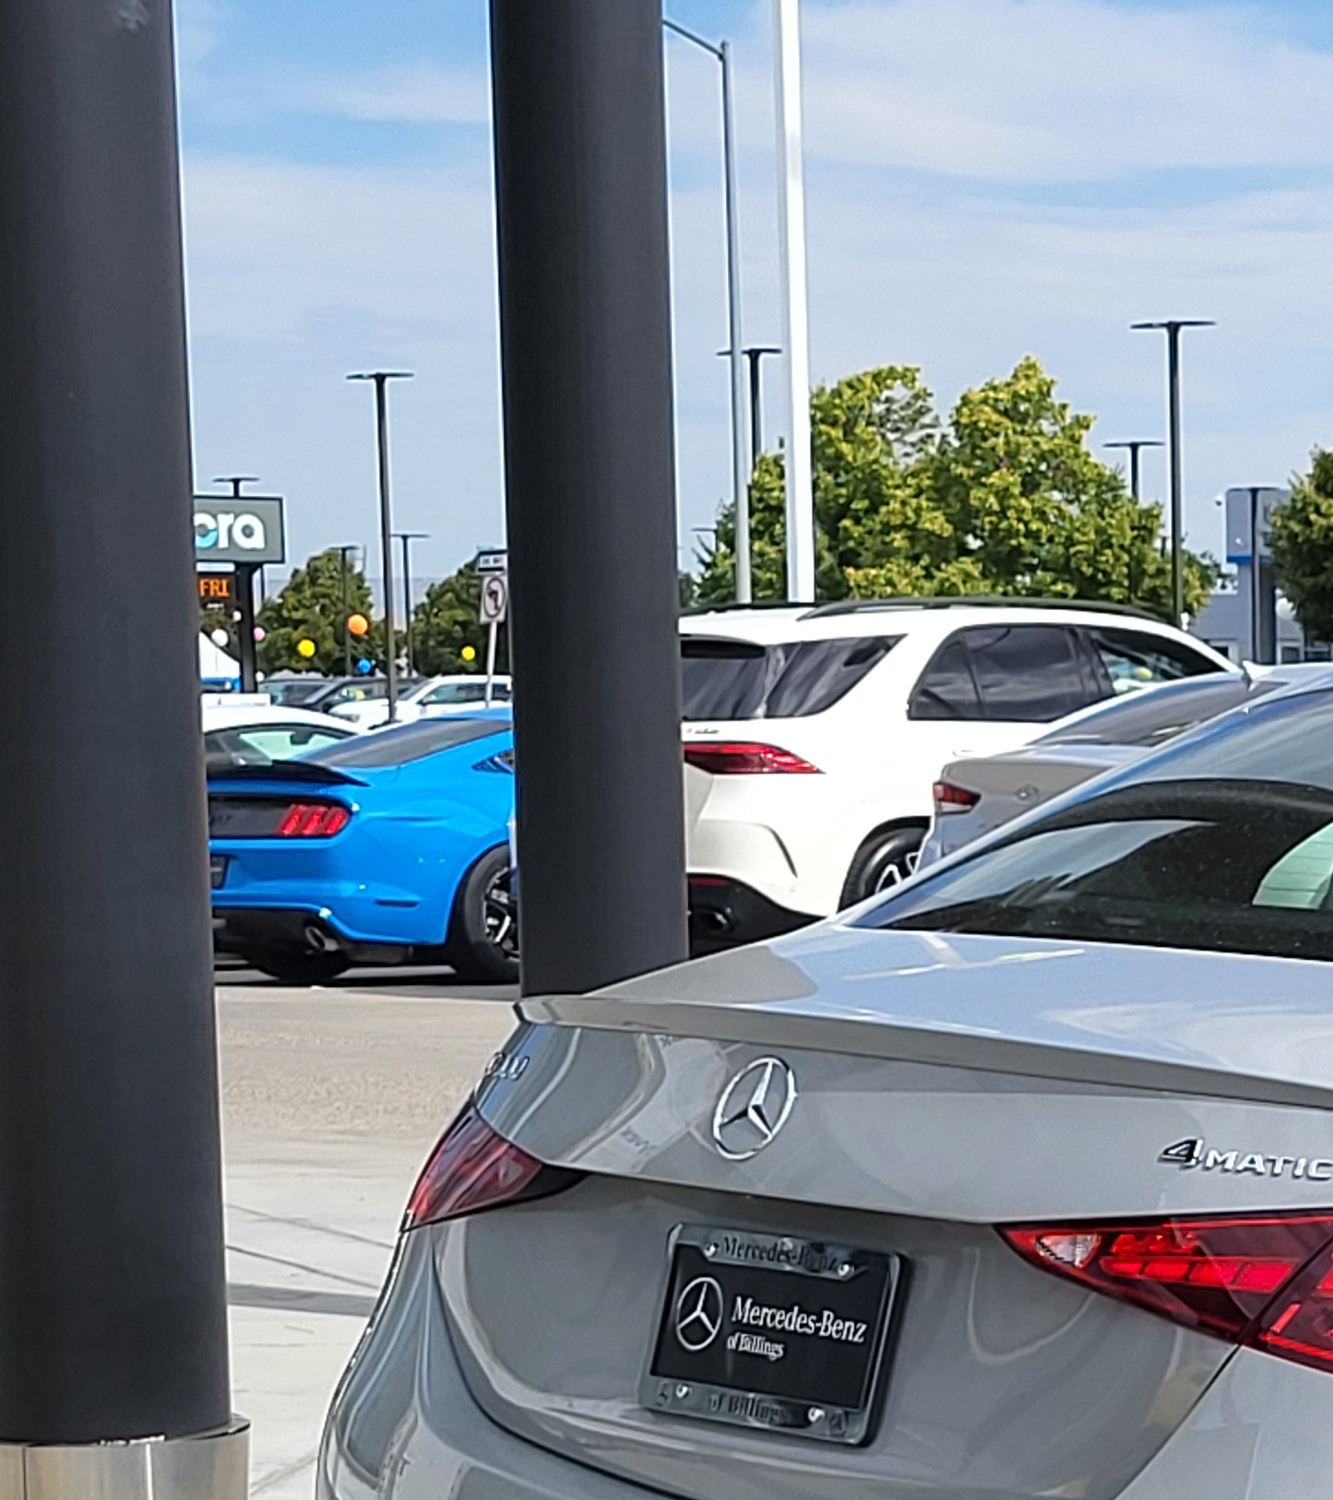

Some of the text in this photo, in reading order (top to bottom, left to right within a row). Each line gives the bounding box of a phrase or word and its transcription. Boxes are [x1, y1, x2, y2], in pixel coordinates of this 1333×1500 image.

[199, 578, 230, 597] FRI
[731, 1296, 867, 1343] Mercedes-Benz
[727, 1333, 785, 1361] of Billings
